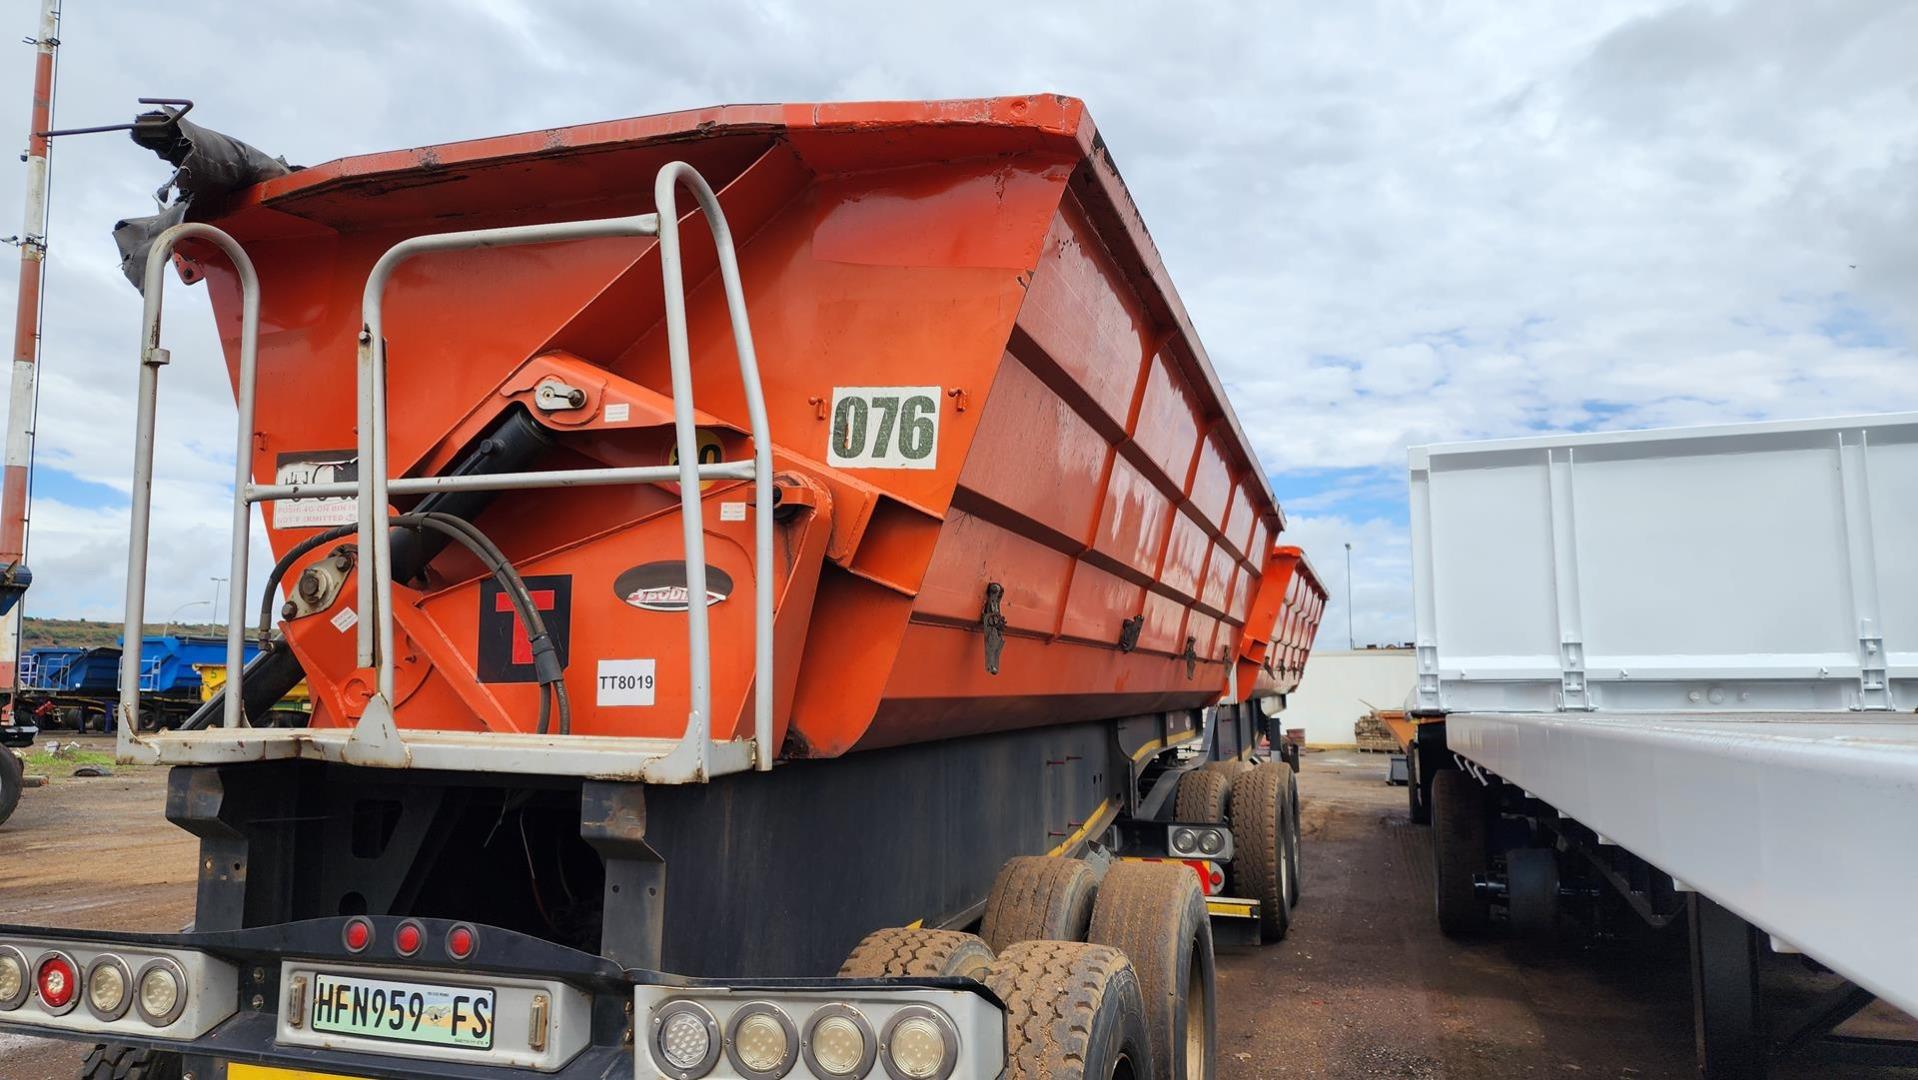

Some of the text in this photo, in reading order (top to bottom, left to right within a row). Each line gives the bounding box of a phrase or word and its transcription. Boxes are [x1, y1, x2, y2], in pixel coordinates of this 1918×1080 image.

[833, 395, 936, 460] 076
[599, 675, 654, 690] TT8019
[316, 982, 489, 1039] HFN959 FS
